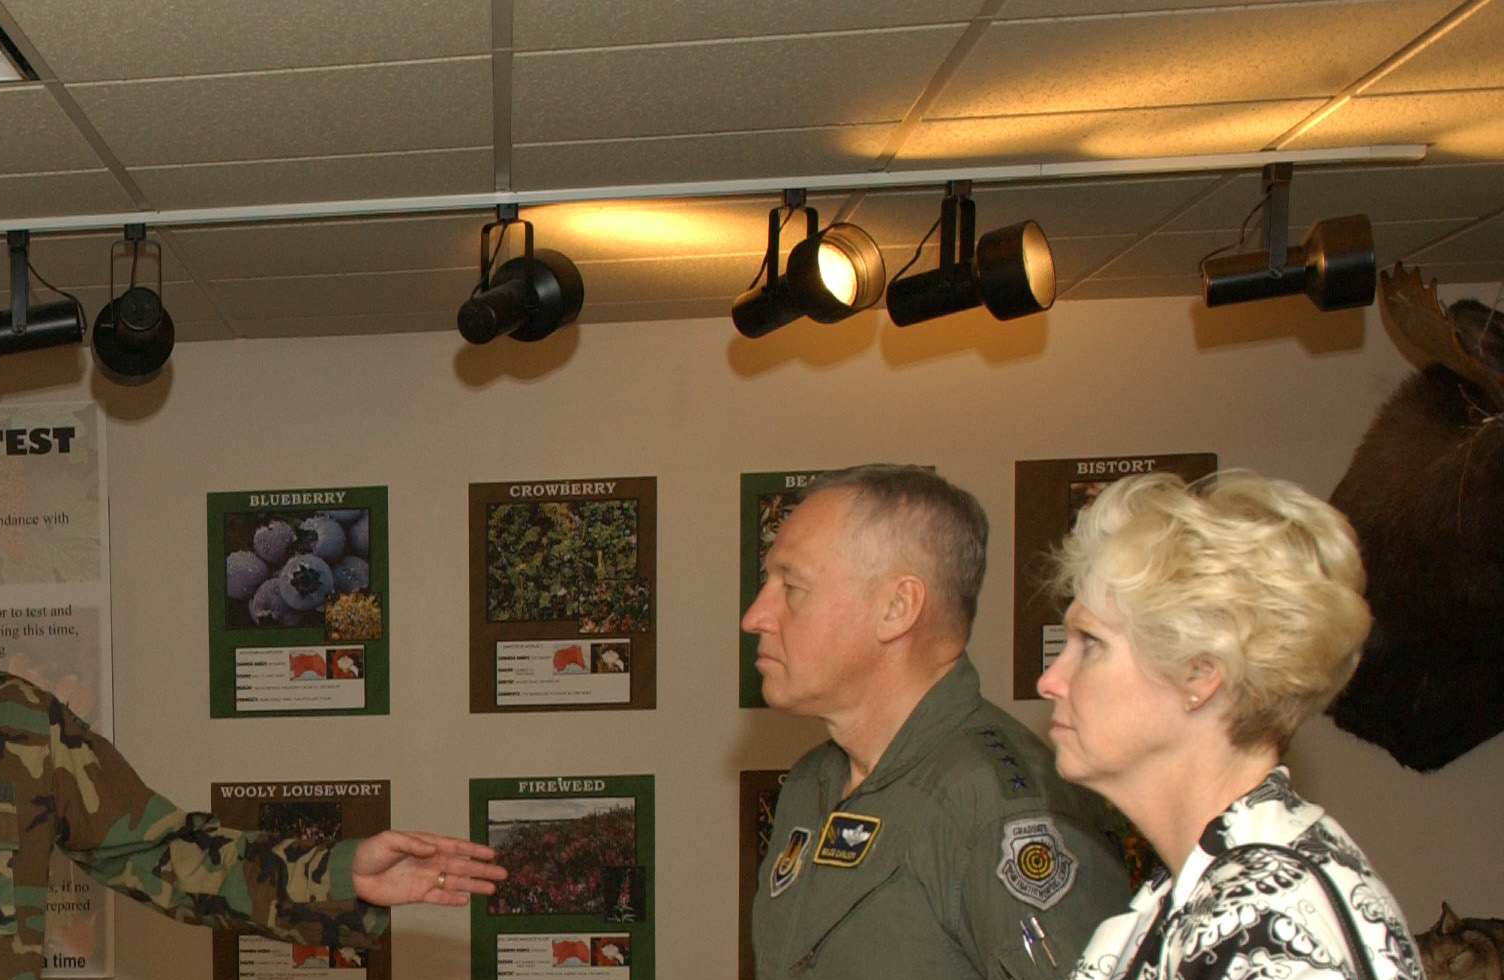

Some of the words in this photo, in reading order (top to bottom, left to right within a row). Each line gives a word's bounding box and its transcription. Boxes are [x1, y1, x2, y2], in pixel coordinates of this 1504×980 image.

[1076, 459, 1156, 475] BISTORT
[509, 481, 617, 498] CROWBERRY
[249, 491, 346, 507] BLUEBERRY
[44, 511, 70, 526] with
[11, 606, 23, 618] to
[26, 605, 47, 618] test
[50, 604, 73, 617] and
[23, 624, 45, 637] this
[48, 624, 79, 637] time,
[220, 785, 277, 798] WOOLY
[282, 783, 382, 798] LOUSEWORT
[518, 779, 606, 793] FIREWEED
[62, 879, 72, 892] if
[74, 882, 90, 892] no
[46, 899, 90, 915] repared
[52, 953, 86, 969] time
